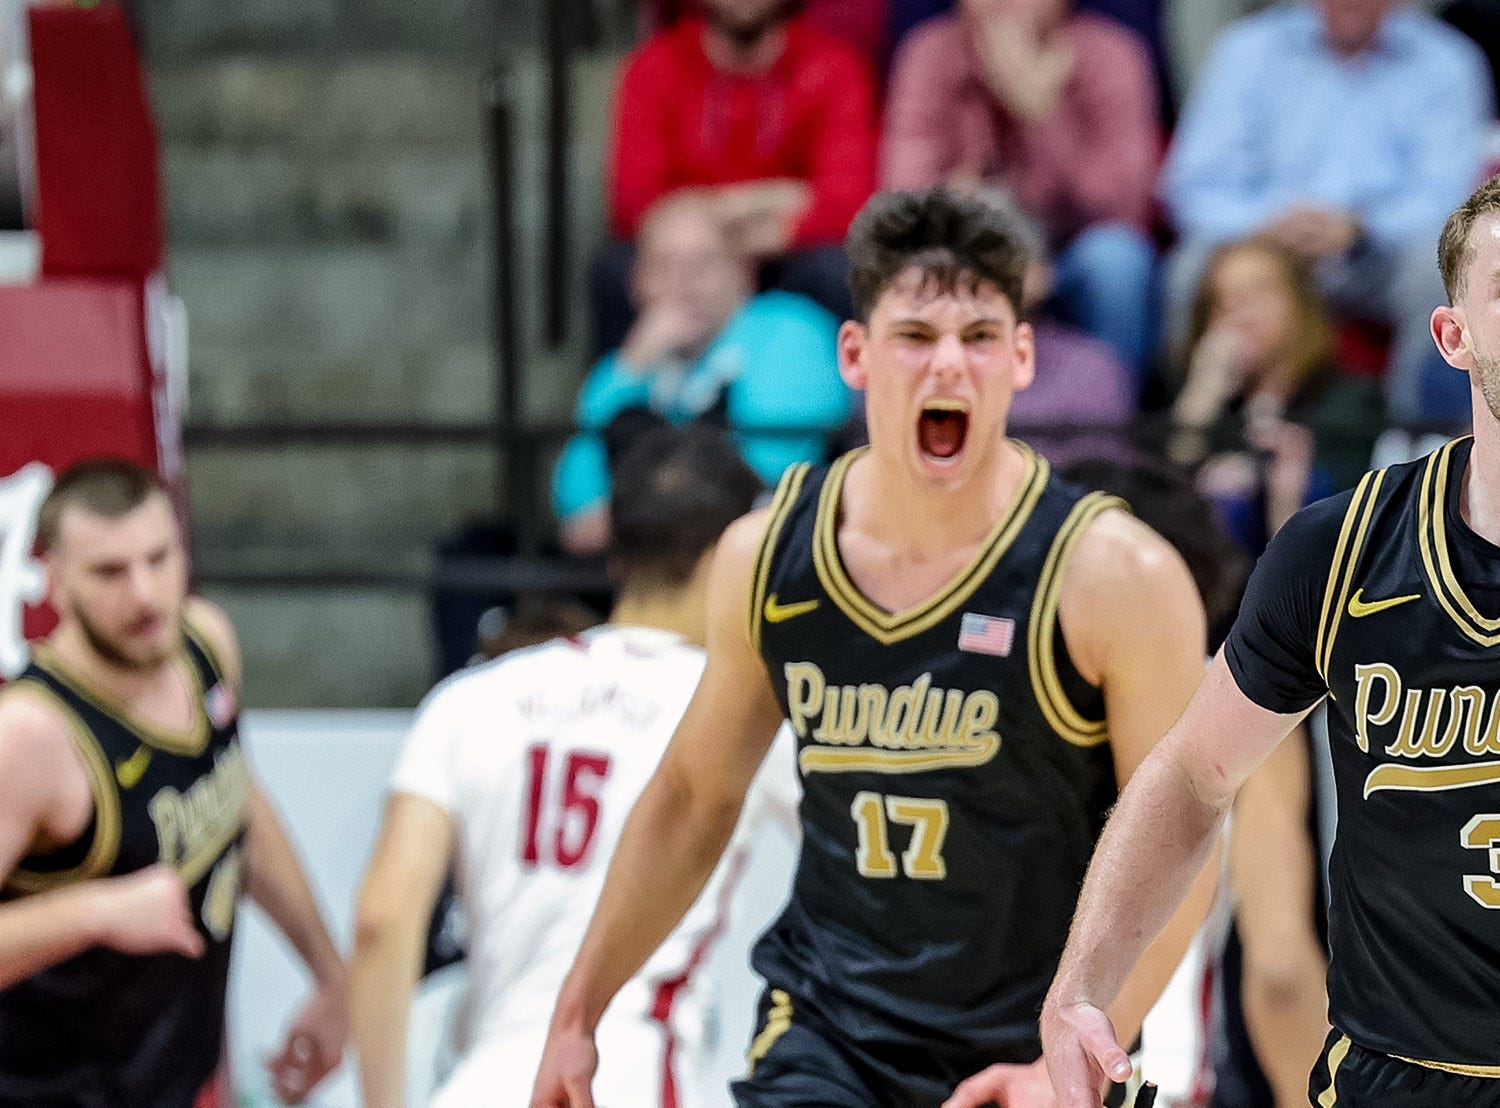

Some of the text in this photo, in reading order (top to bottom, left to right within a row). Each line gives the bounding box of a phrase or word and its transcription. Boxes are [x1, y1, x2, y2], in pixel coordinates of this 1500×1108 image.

[784, 661, 1001, 752] Purdue
[519, 741, 614, 872] 15
[851, 790, 949, 880] 17
